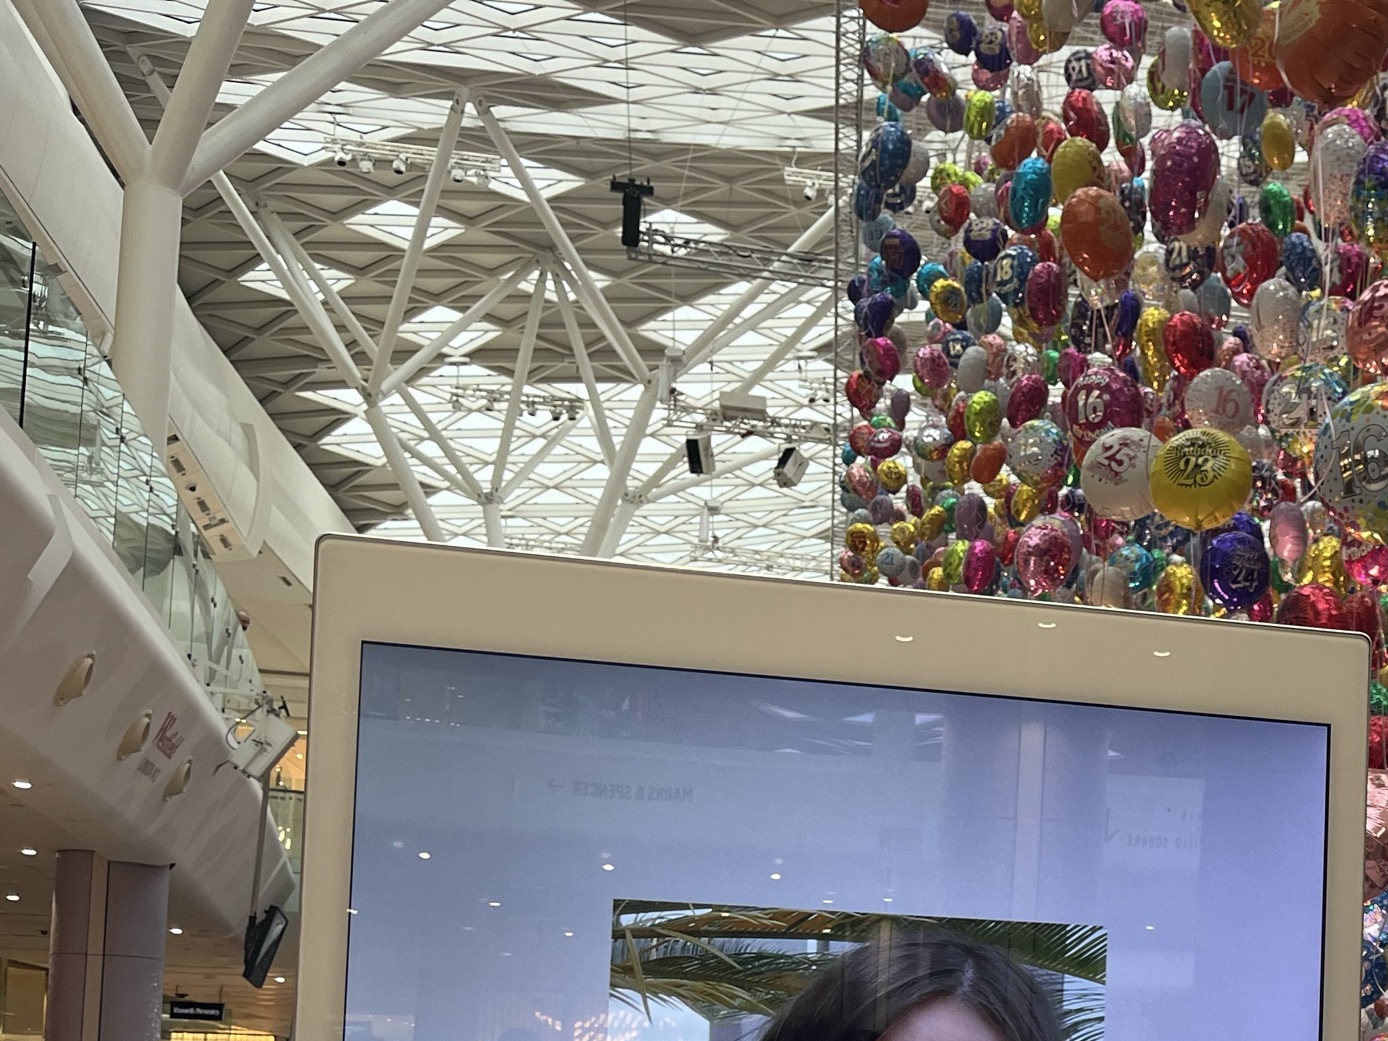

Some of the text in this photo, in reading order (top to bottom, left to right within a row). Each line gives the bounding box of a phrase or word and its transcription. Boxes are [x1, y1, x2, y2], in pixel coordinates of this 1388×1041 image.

[1224, 85, 1256, 114] 17
[1076, 389, 1106, 424] 16
[1215, 385, 1240, 419] 16
[1278, 383, 1322, 430] 21
[1095, 440, 1134, 474] 25
[1178, 455, 1216, 487] 23
[1231, 569, 1259, 593] 24
